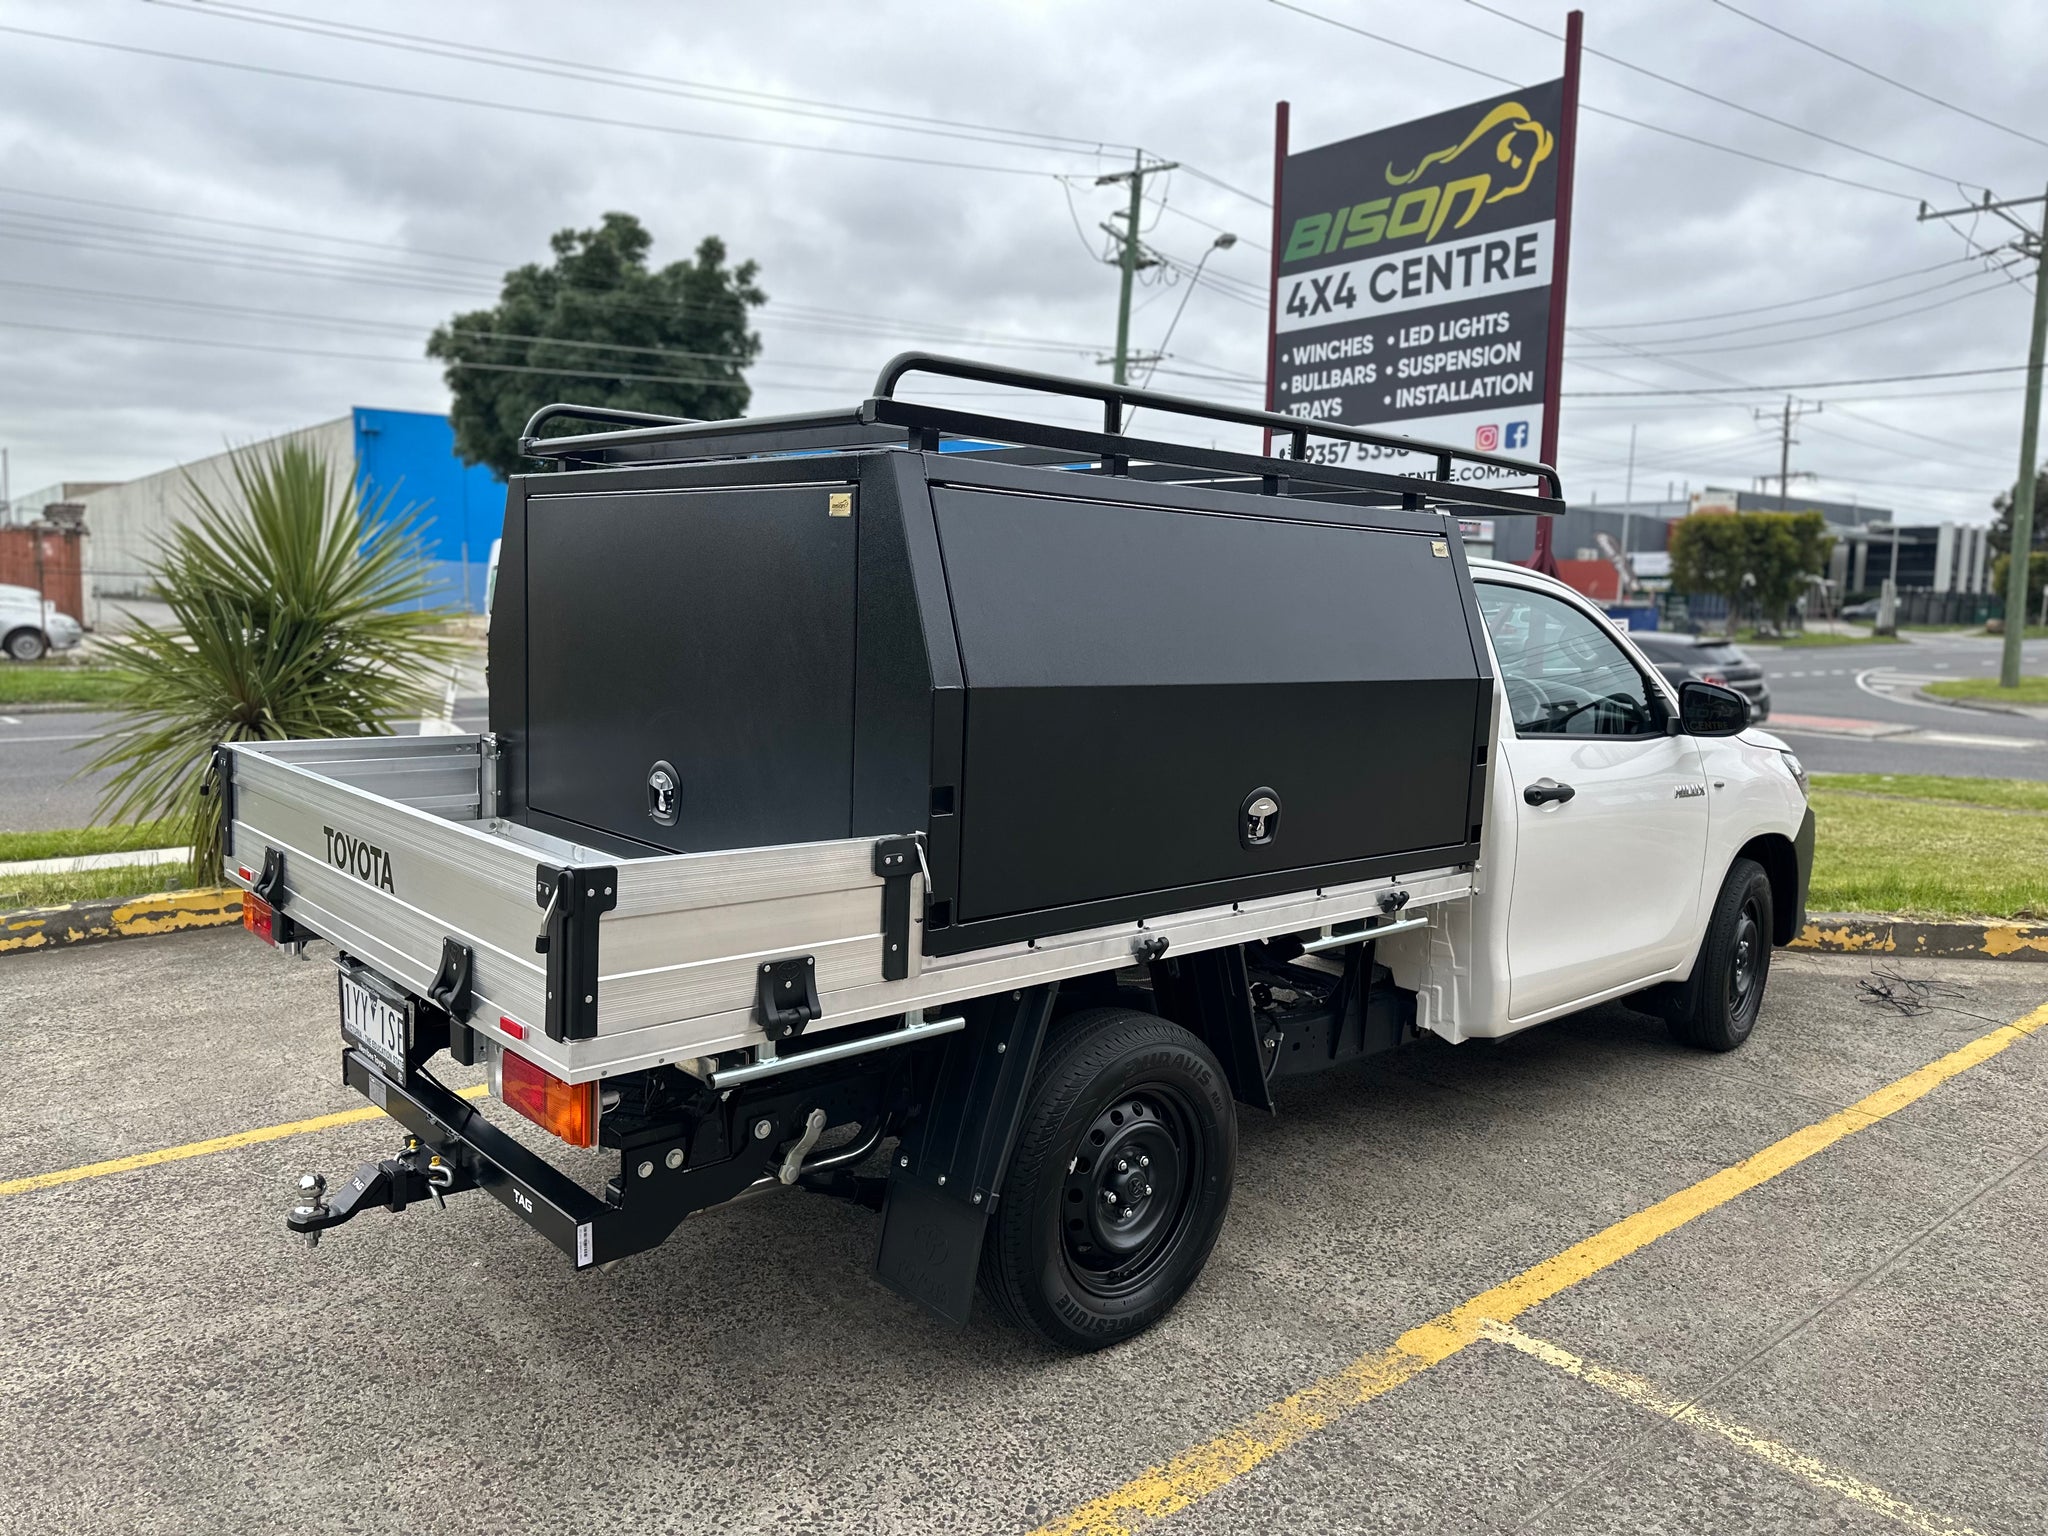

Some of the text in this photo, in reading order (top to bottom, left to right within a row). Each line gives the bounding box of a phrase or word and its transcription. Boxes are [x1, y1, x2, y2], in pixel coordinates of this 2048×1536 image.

[1283, 173, 1492, 262] BISON
[1286, 232, 1539, 318] 4X4 CENTRE
[1292, 334, 1375, 366] WINCHES
[1399, 312, 1510, 350] LED LIGHTS
[1291, 363, 1377, 395] BULLBARS
[1397, 341, 1522, 380] SUSPENSION
[1289, 397, 1343, 419] TRAYS
[1396, 371, 1534, 409] INSTALLATION
[1305, 441, 1351, 465] 9357
[323, 825, 395, 894] TOYOTA
[345, 983, 404, 1056] 1YY 1SE
[513, 1188, 533, 1213] TAG
